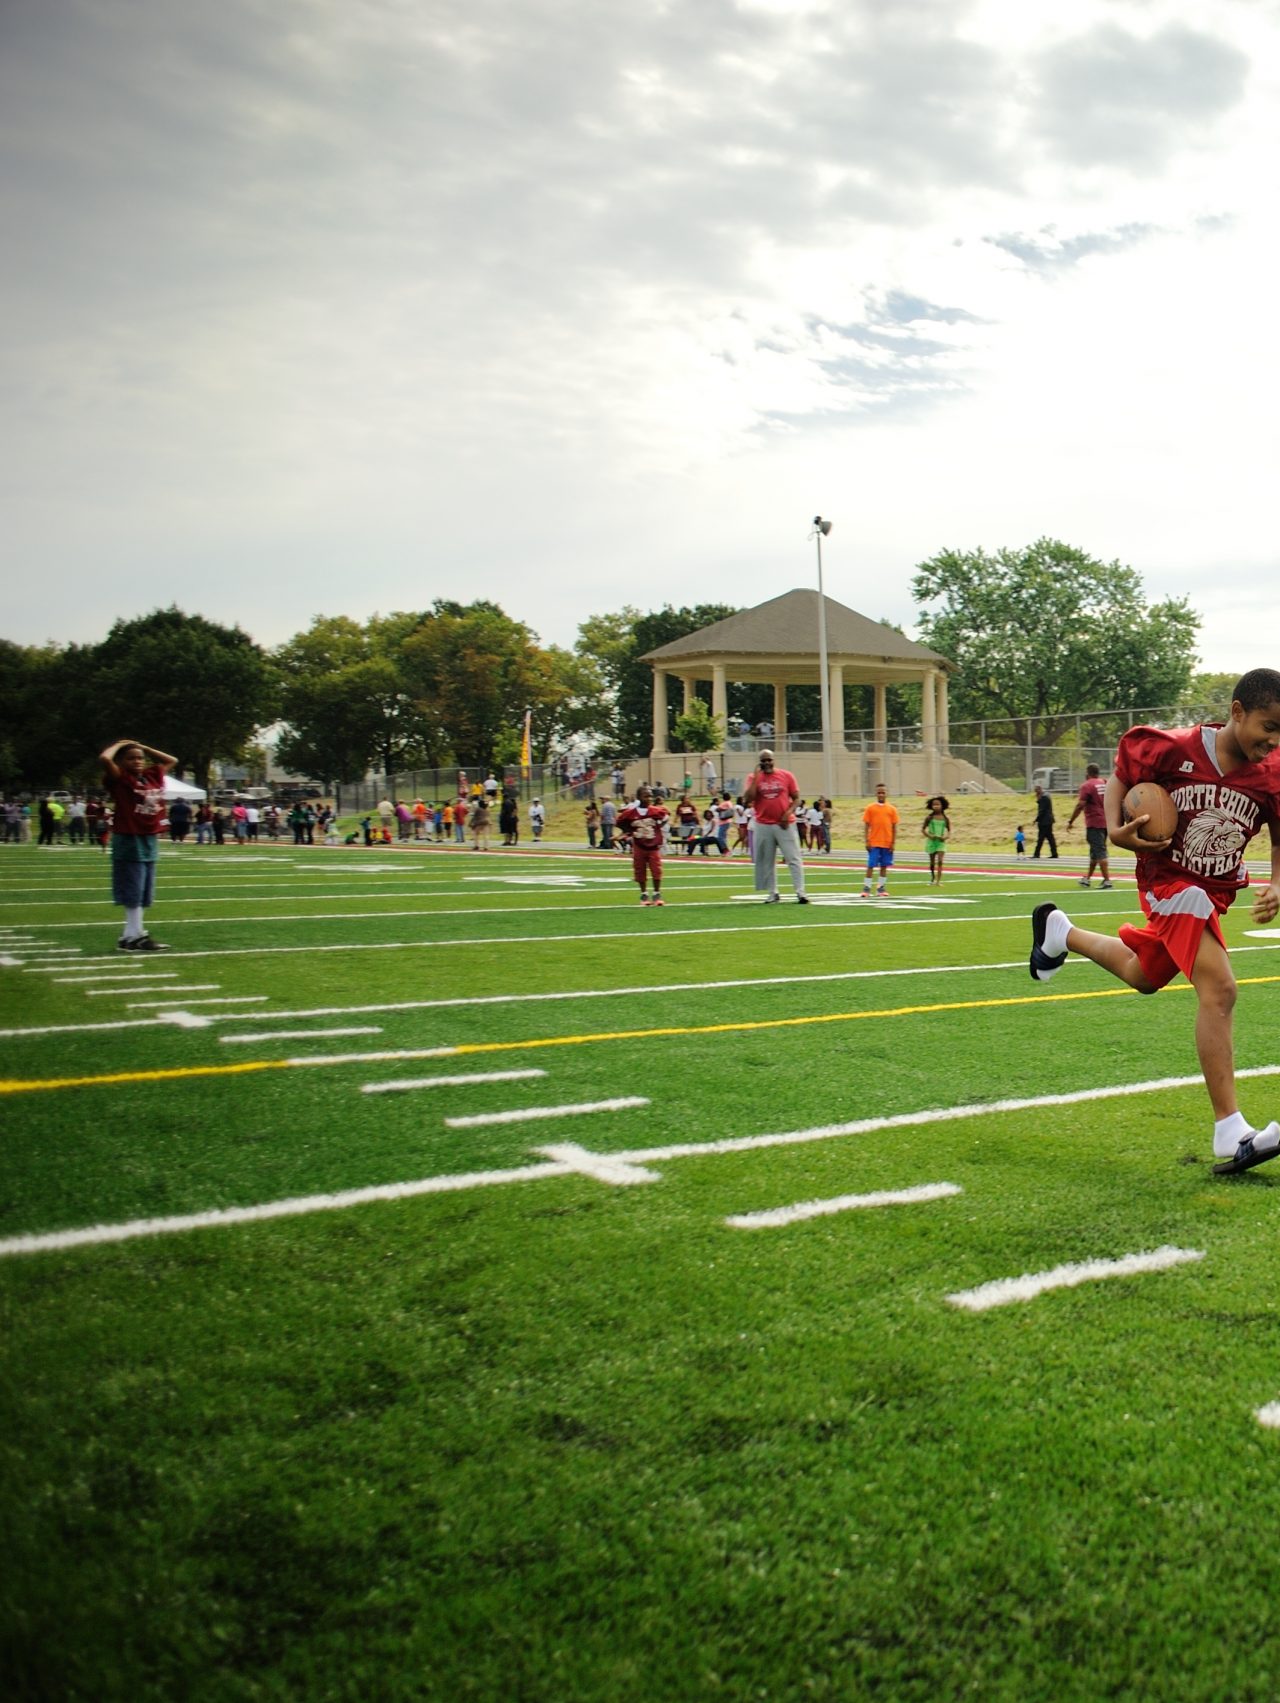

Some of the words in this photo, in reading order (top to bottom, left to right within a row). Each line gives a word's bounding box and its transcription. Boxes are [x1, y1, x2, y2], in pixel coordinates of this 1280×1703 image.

[1170, 784, 1217, 812] NORTH
[1219, 786, 1260, 831] PHILLY
[1172, 849, 1242, 878] FOOTBAL
